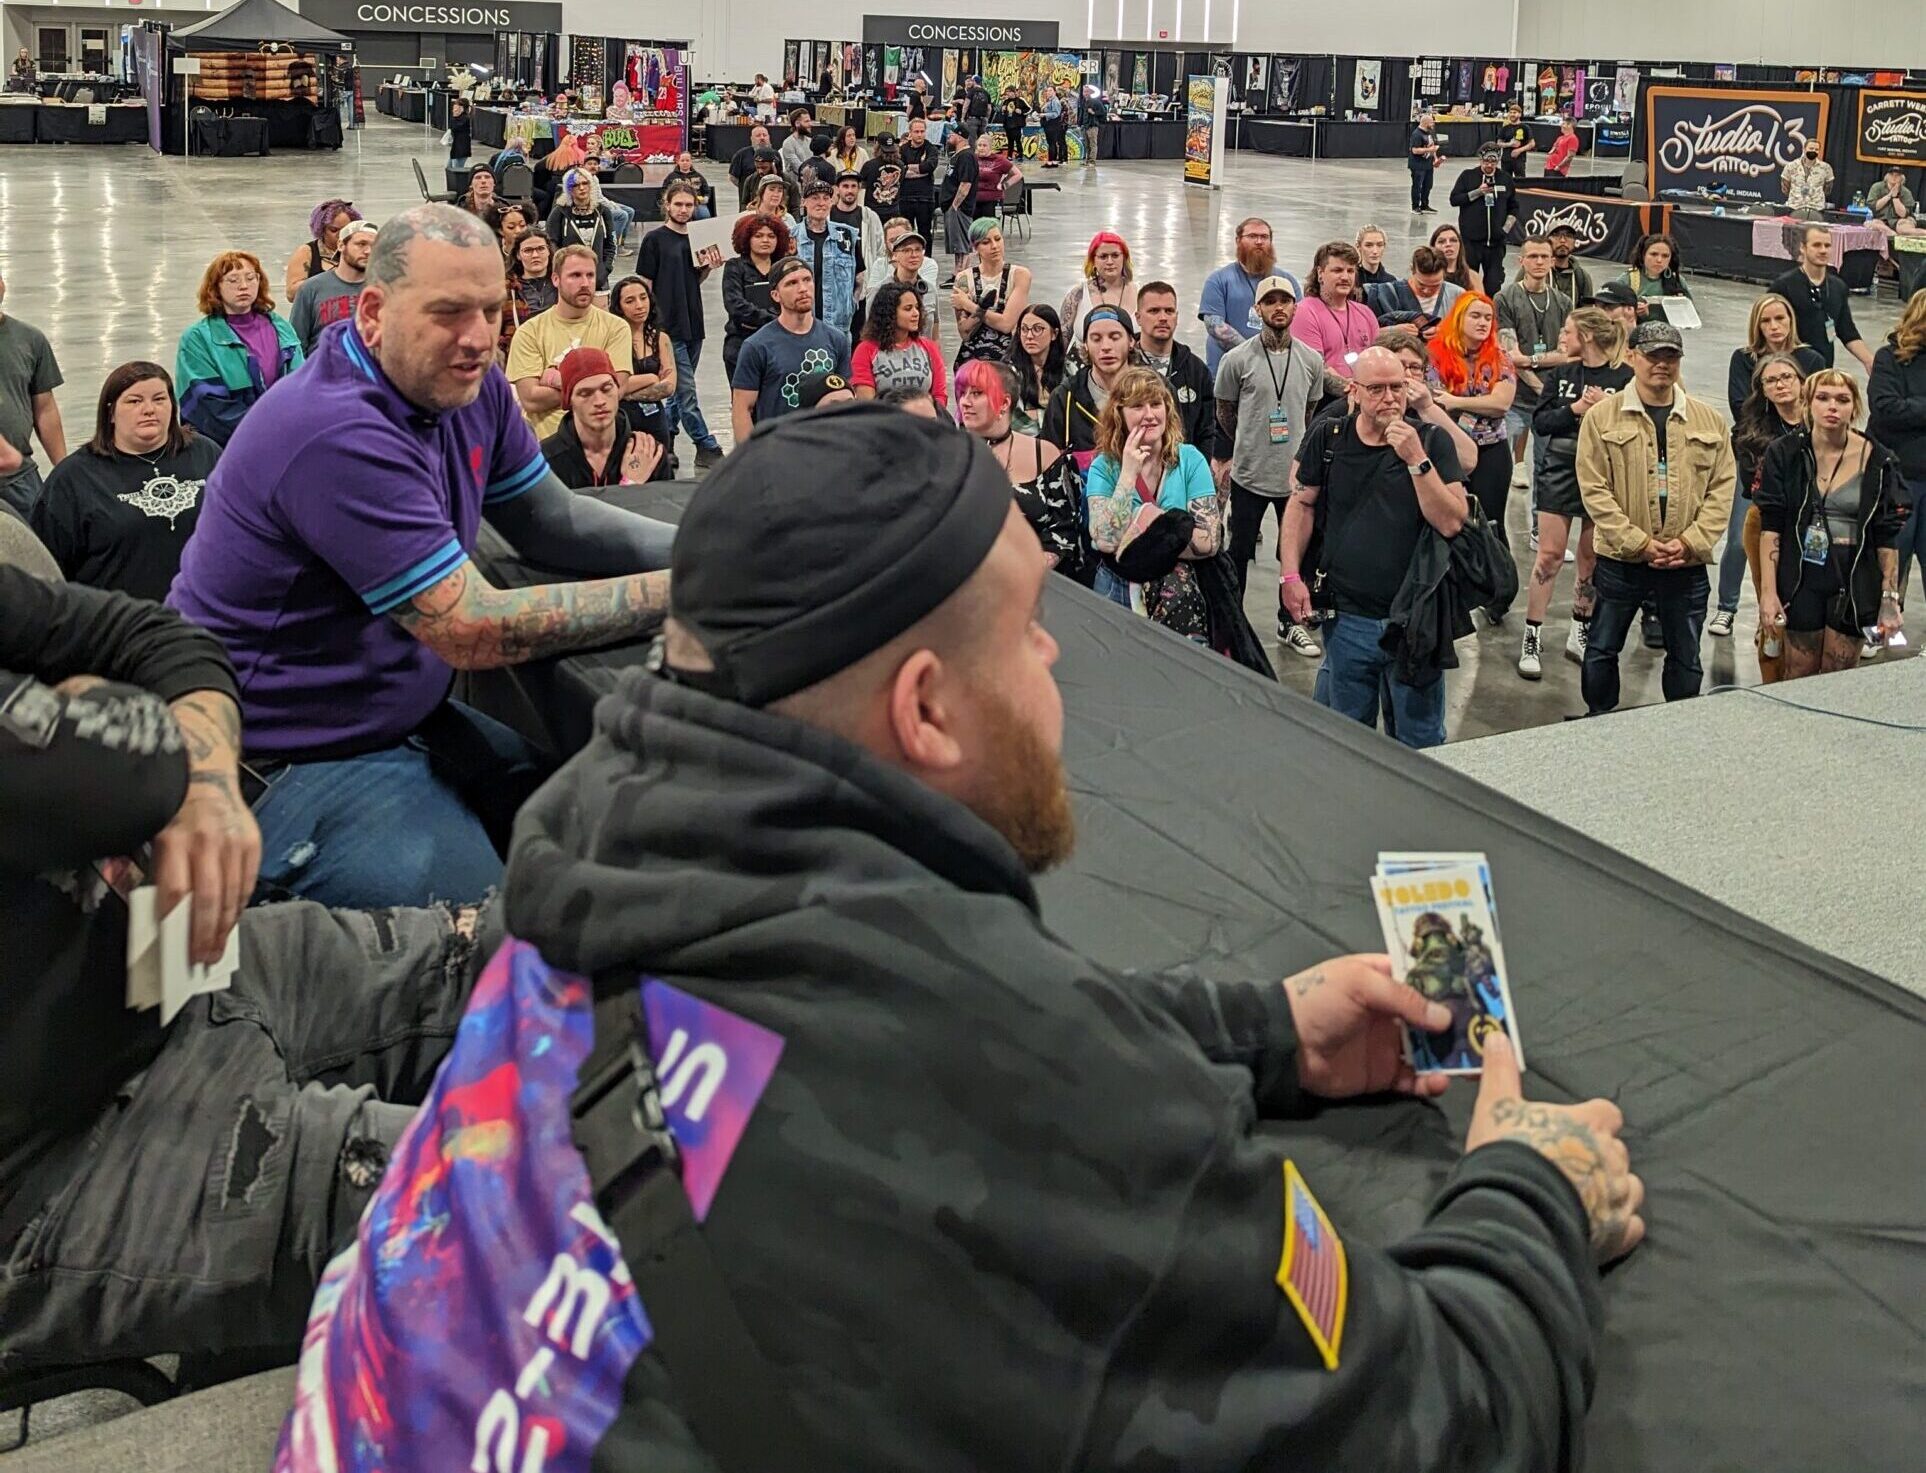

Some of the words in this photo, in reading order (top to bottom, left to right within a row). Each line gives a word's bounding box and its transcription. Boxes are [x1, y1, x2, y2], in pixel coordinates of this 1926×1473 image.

[357, 4, 511, 26] CONCESSIONS
[908, 24, 1022, 42] CONCESSIONS
[1866, 99, 1906, 113] GARRETT
[1695, 155, 1776, 178] TATTOO
[876, 357, 930, 379] GLASS
[1380, 879, 1470, 907] TOLEDO
